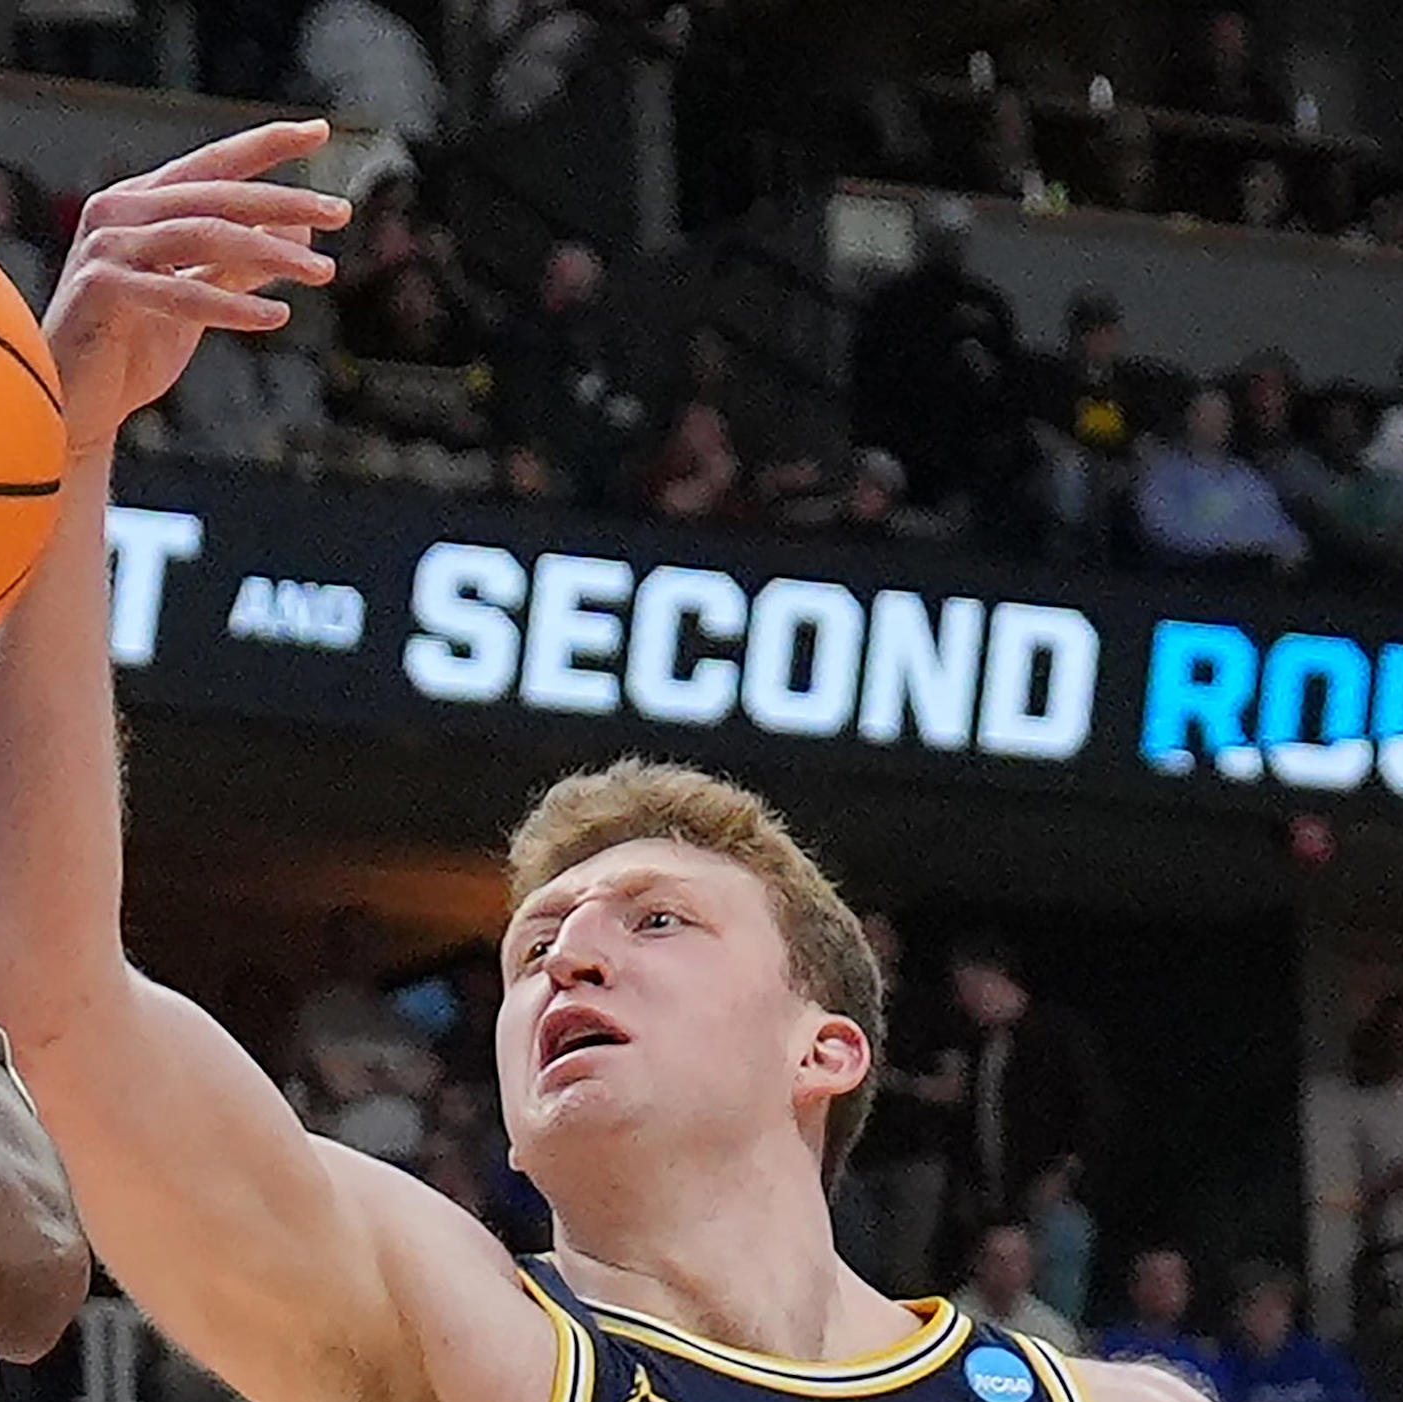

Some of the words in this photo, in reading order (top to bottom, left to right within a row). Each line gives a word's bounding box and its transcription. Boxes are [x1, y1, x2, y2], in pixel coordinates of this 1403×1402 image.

[227, 574, 365, 651] AND
[404, 541, 1100, 761] SECOND
[973, 1373, 1033, 1394] NCAA
